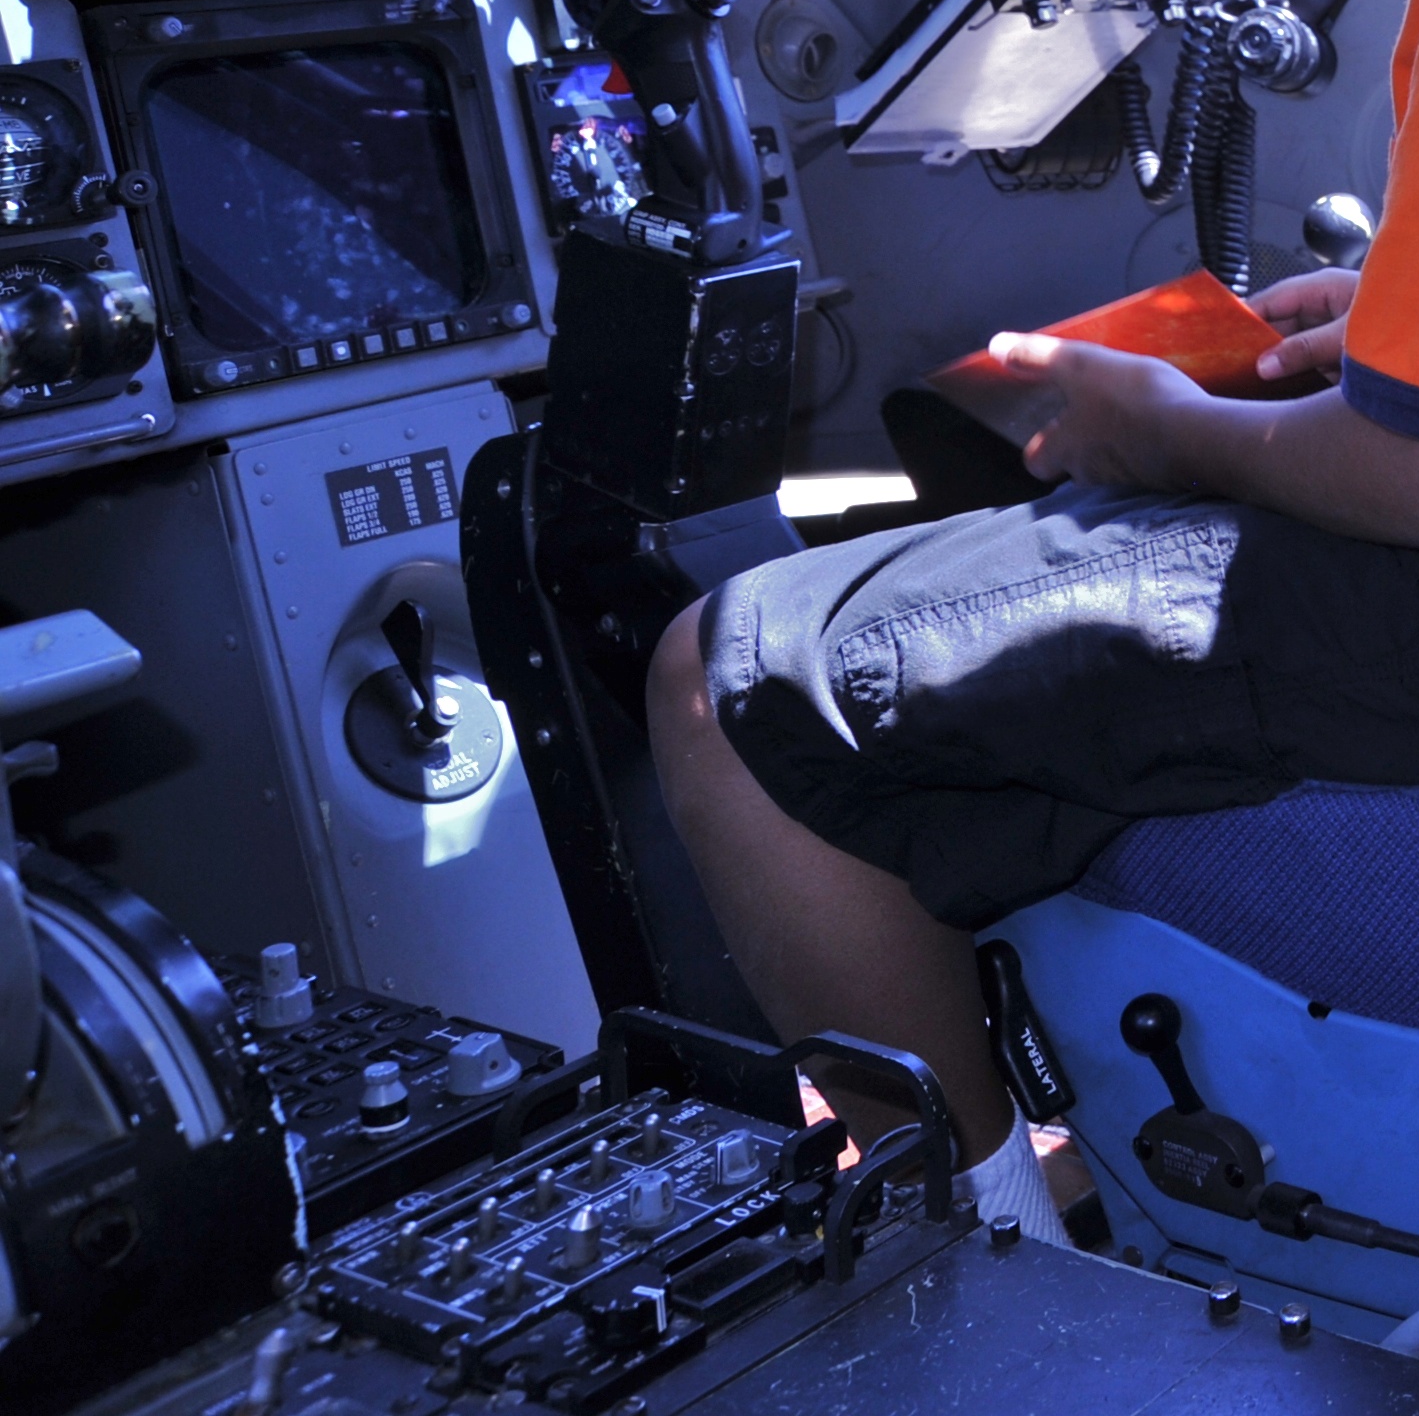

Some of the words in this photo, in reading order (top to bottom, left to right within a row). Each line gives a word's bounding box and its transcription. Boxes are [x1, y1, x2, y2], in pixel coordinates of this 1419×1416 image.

[366, 462, 387, 473] LIMIT
[388, 456, 411, 469] SPEED
[366, 493, 380, 503] EXT
[342, 506, 365, 518] SLATS
[364, 502, 378, 511] EXT
[344, 514, 367, 526] FLAPS
[346, 522, 369, 534] FLAPS
[348, 530, 370, 542] FLAPS
[370, 526, 389, 536] FULL
[431, 761, 480, 791] ADJUST
[1020, 1026, 1058, 1096] LATERAL
[674, 1151, 709, 1170] MODE
[714, 1190, 782, 1227] LOCK
